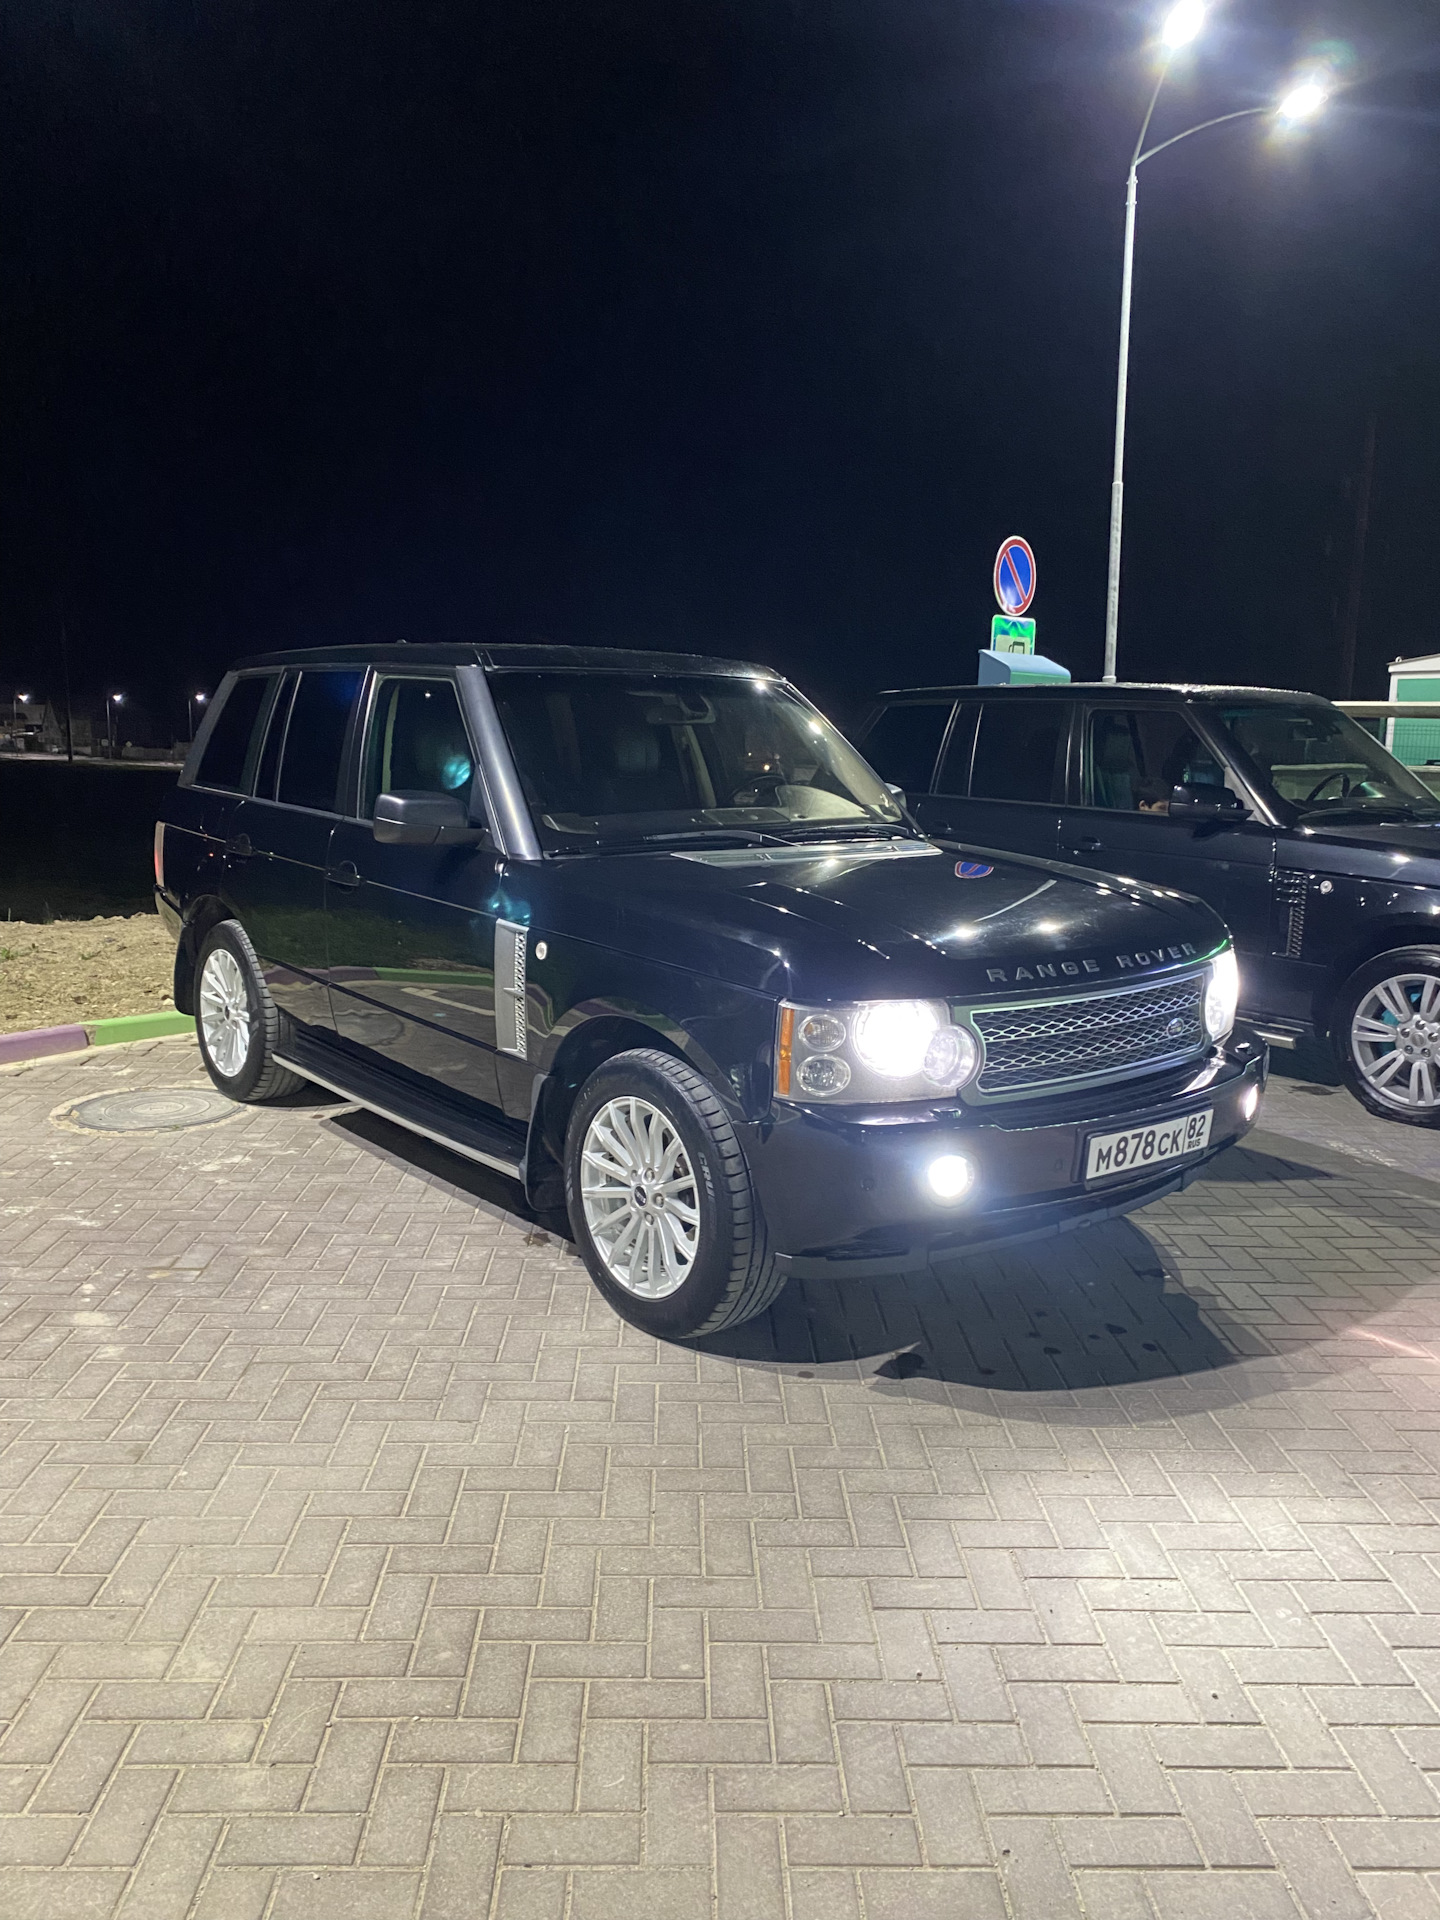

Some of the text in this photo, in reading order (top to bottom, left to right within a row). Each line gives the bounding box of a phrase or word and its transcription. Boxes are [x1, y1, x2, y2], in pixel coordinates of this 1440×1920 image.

[986, 942, 1197, 982] RANGE ROVER
[1187, 1115, 1206, 1140] 82
[1187, 1138, 1201, 1149] RUS
